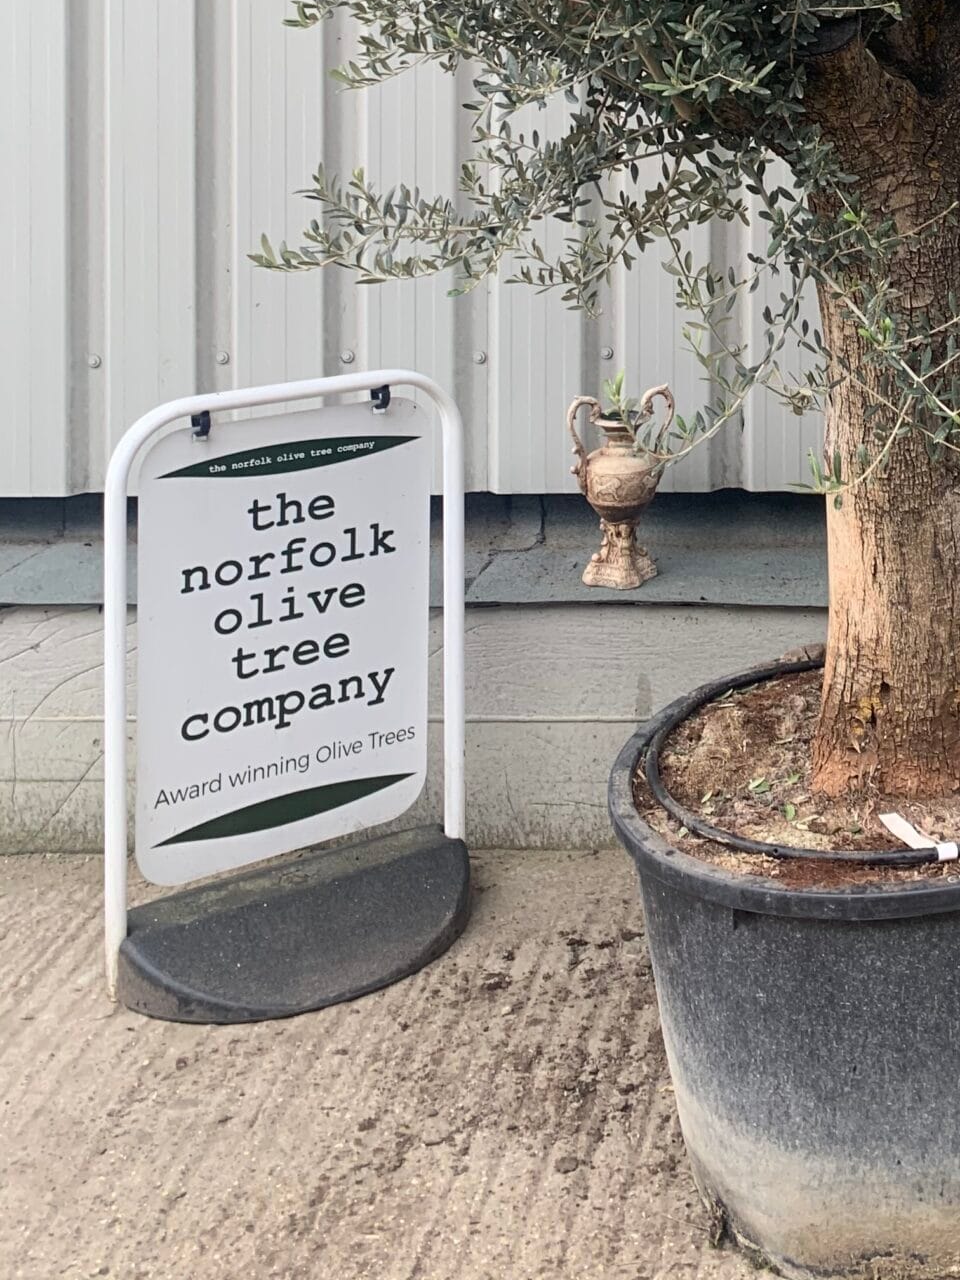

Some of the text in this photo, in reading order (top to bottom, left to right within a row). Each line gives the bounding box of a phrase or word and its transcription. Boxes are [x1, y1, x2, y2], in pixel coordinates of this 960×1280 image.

[208, 441, 375, 473] the norfolk olive tree company
[247, 492, 335, 531] the
[180, 522, 397, 595] norfolk
[214, 582, 366, 635] olive
[231, 632, 350, 680] tree
[181, 667, 396, 742] company
[154, 727, 415, 809] Award winning Olive Trees
